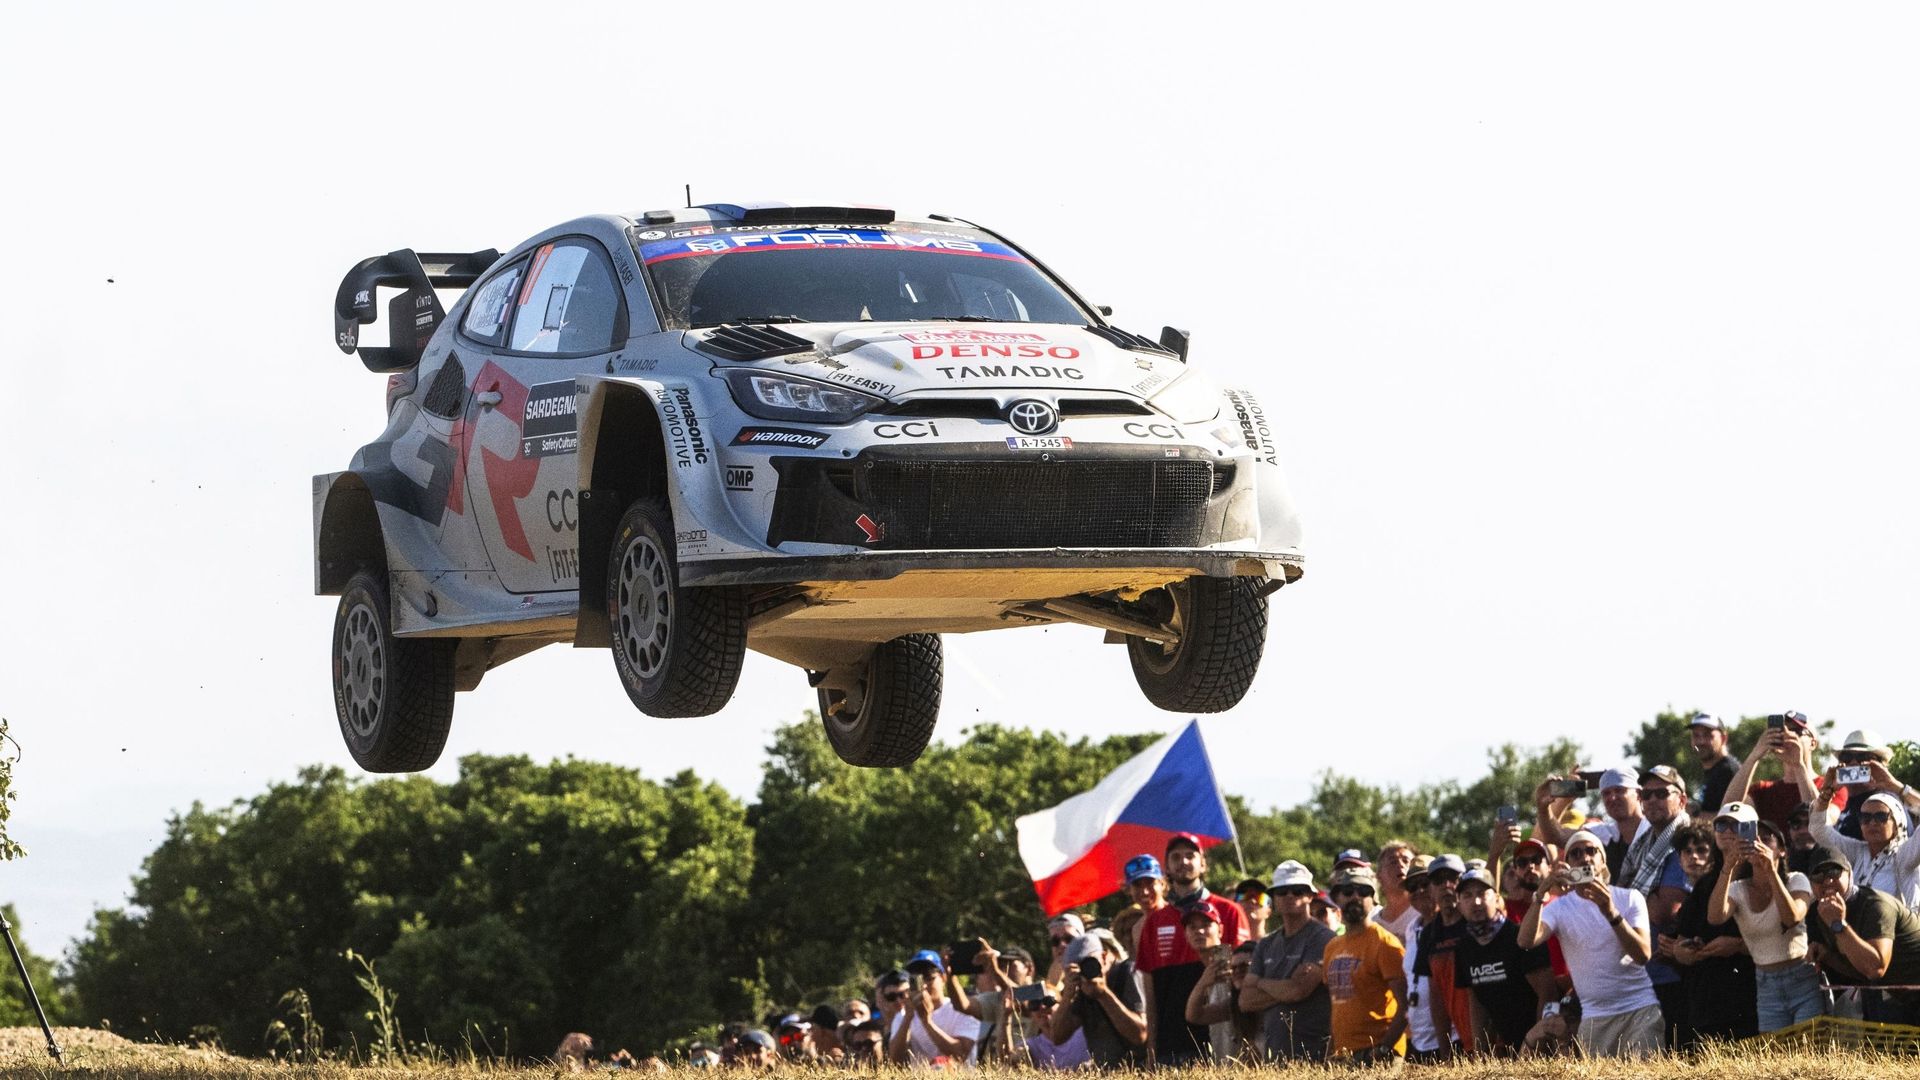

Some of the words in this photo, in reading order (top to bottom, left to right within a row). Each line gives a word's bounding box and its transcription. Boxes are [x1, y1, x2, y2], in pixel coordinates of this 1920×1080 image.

[912, 345, 1080, 360] DENSO
[620, 359, 659, 371] TAMADIC
[936, 365, 1084, 380] TAMADIC
[526, 394, 577, 420] SARDEGNA
[654, 388, 692, 469] AUTOMOTIVE
[671, 386, 708, 465] Panasonic
[1238, 388, 1278, 467] AUTOMOTIVE
[1021, 438, 1061, 448] A-7545
[726, 469, 754, 487] OMP
[1470, 961, 1506, 977] WRC
